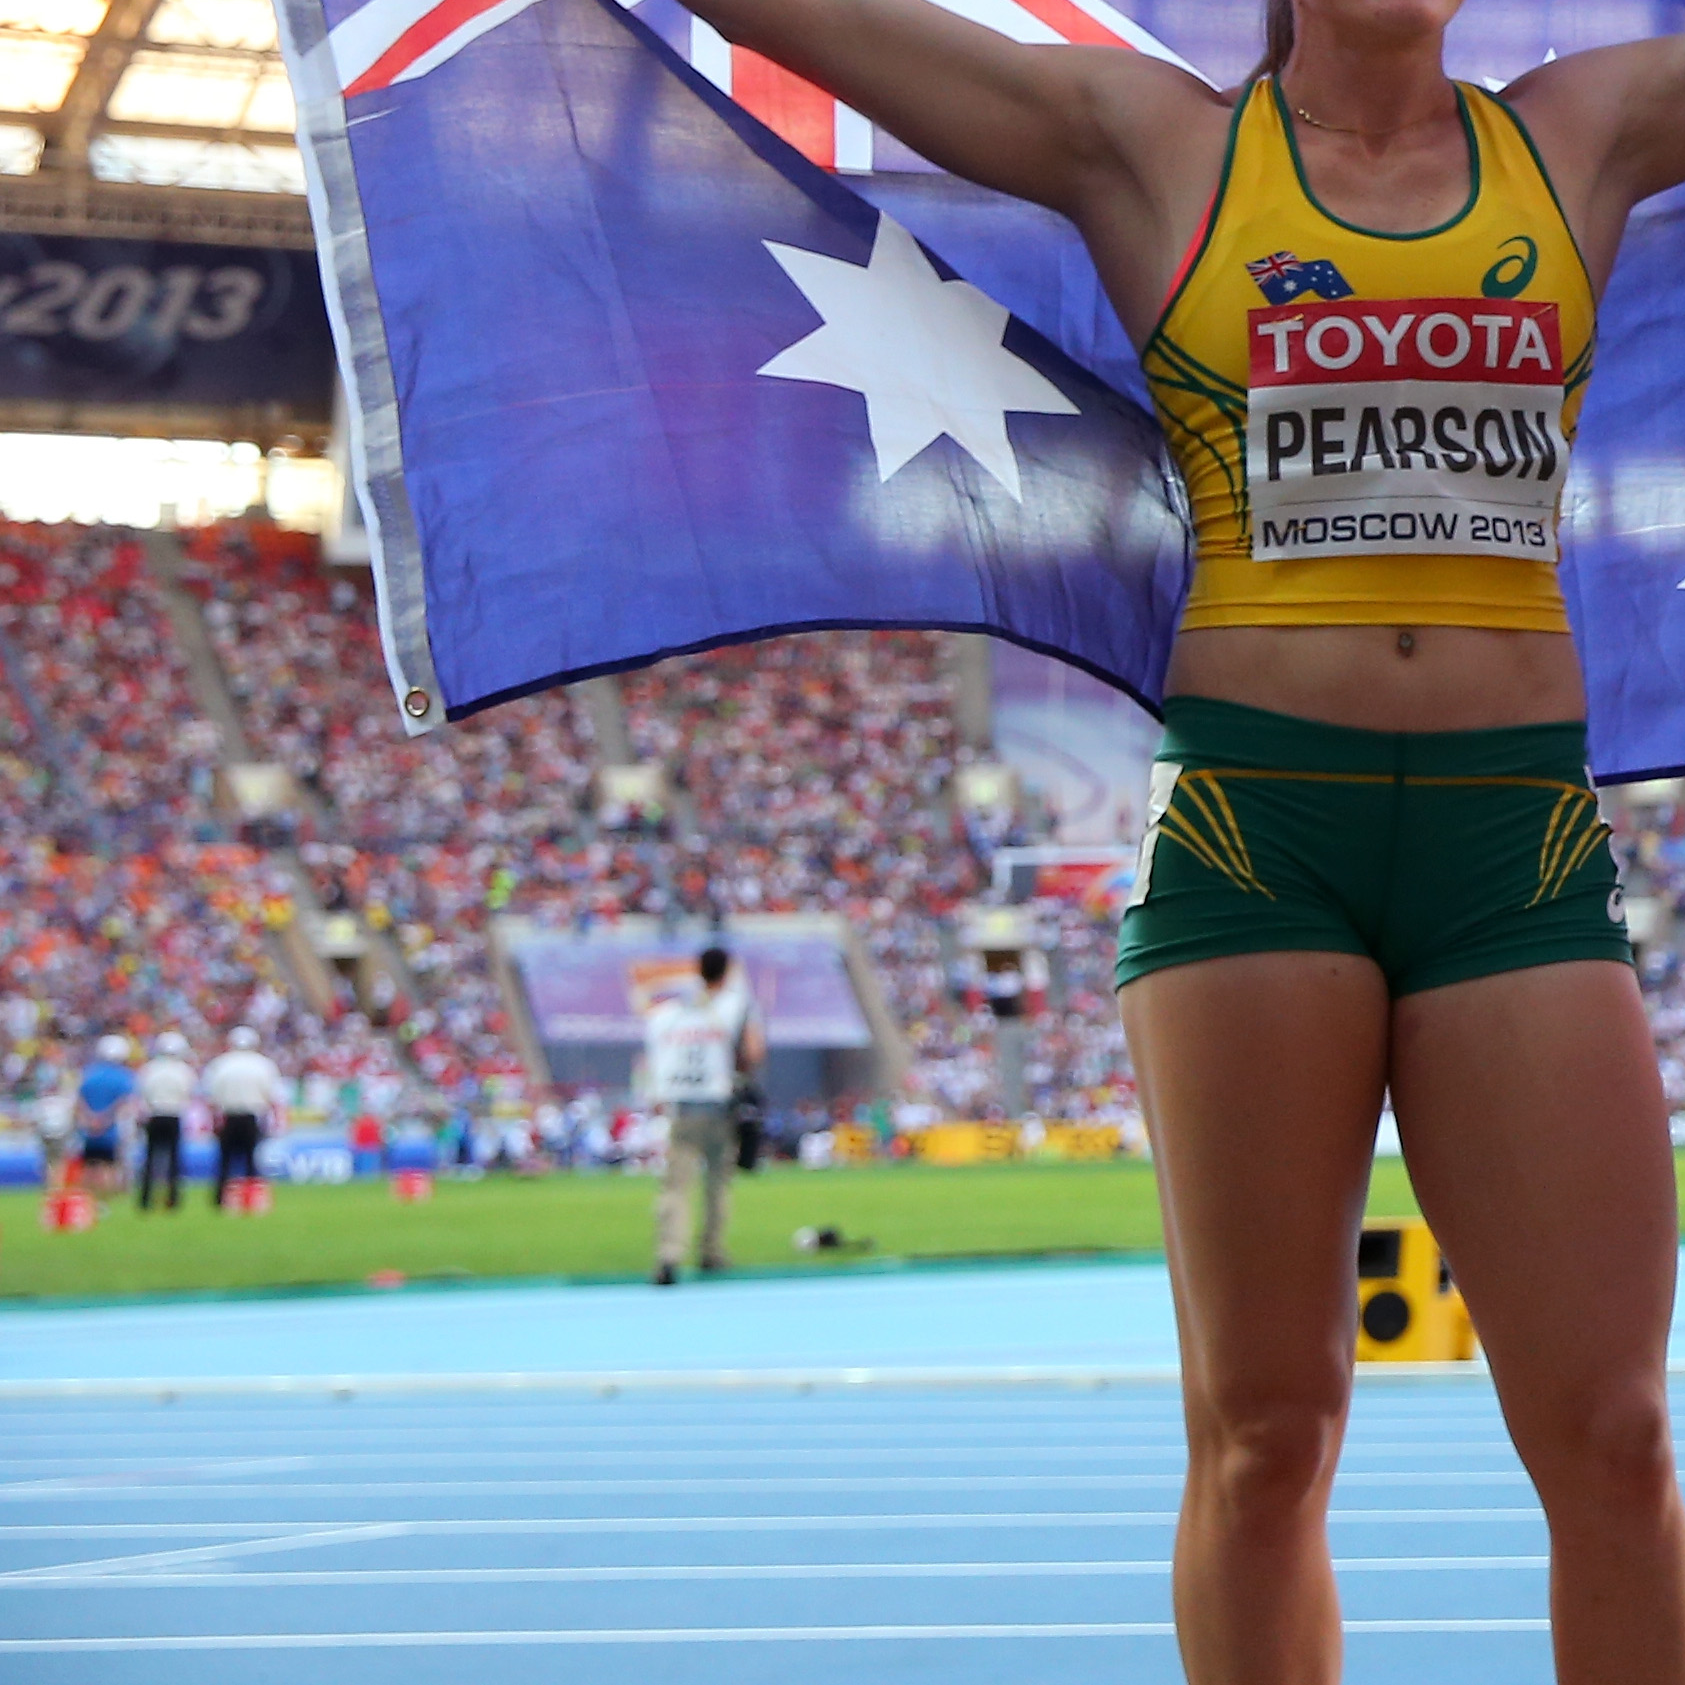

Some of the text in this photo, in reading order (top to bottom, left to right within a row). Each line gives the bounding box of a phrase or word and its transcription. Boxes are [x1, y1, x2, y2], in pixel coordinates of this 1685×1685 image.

[1257, 312, 1553, 374] TOYOTA
[1265, 404, 1558, 483] PEARSON
[1262, 513, 1548, 548] MOSCOW 2013
